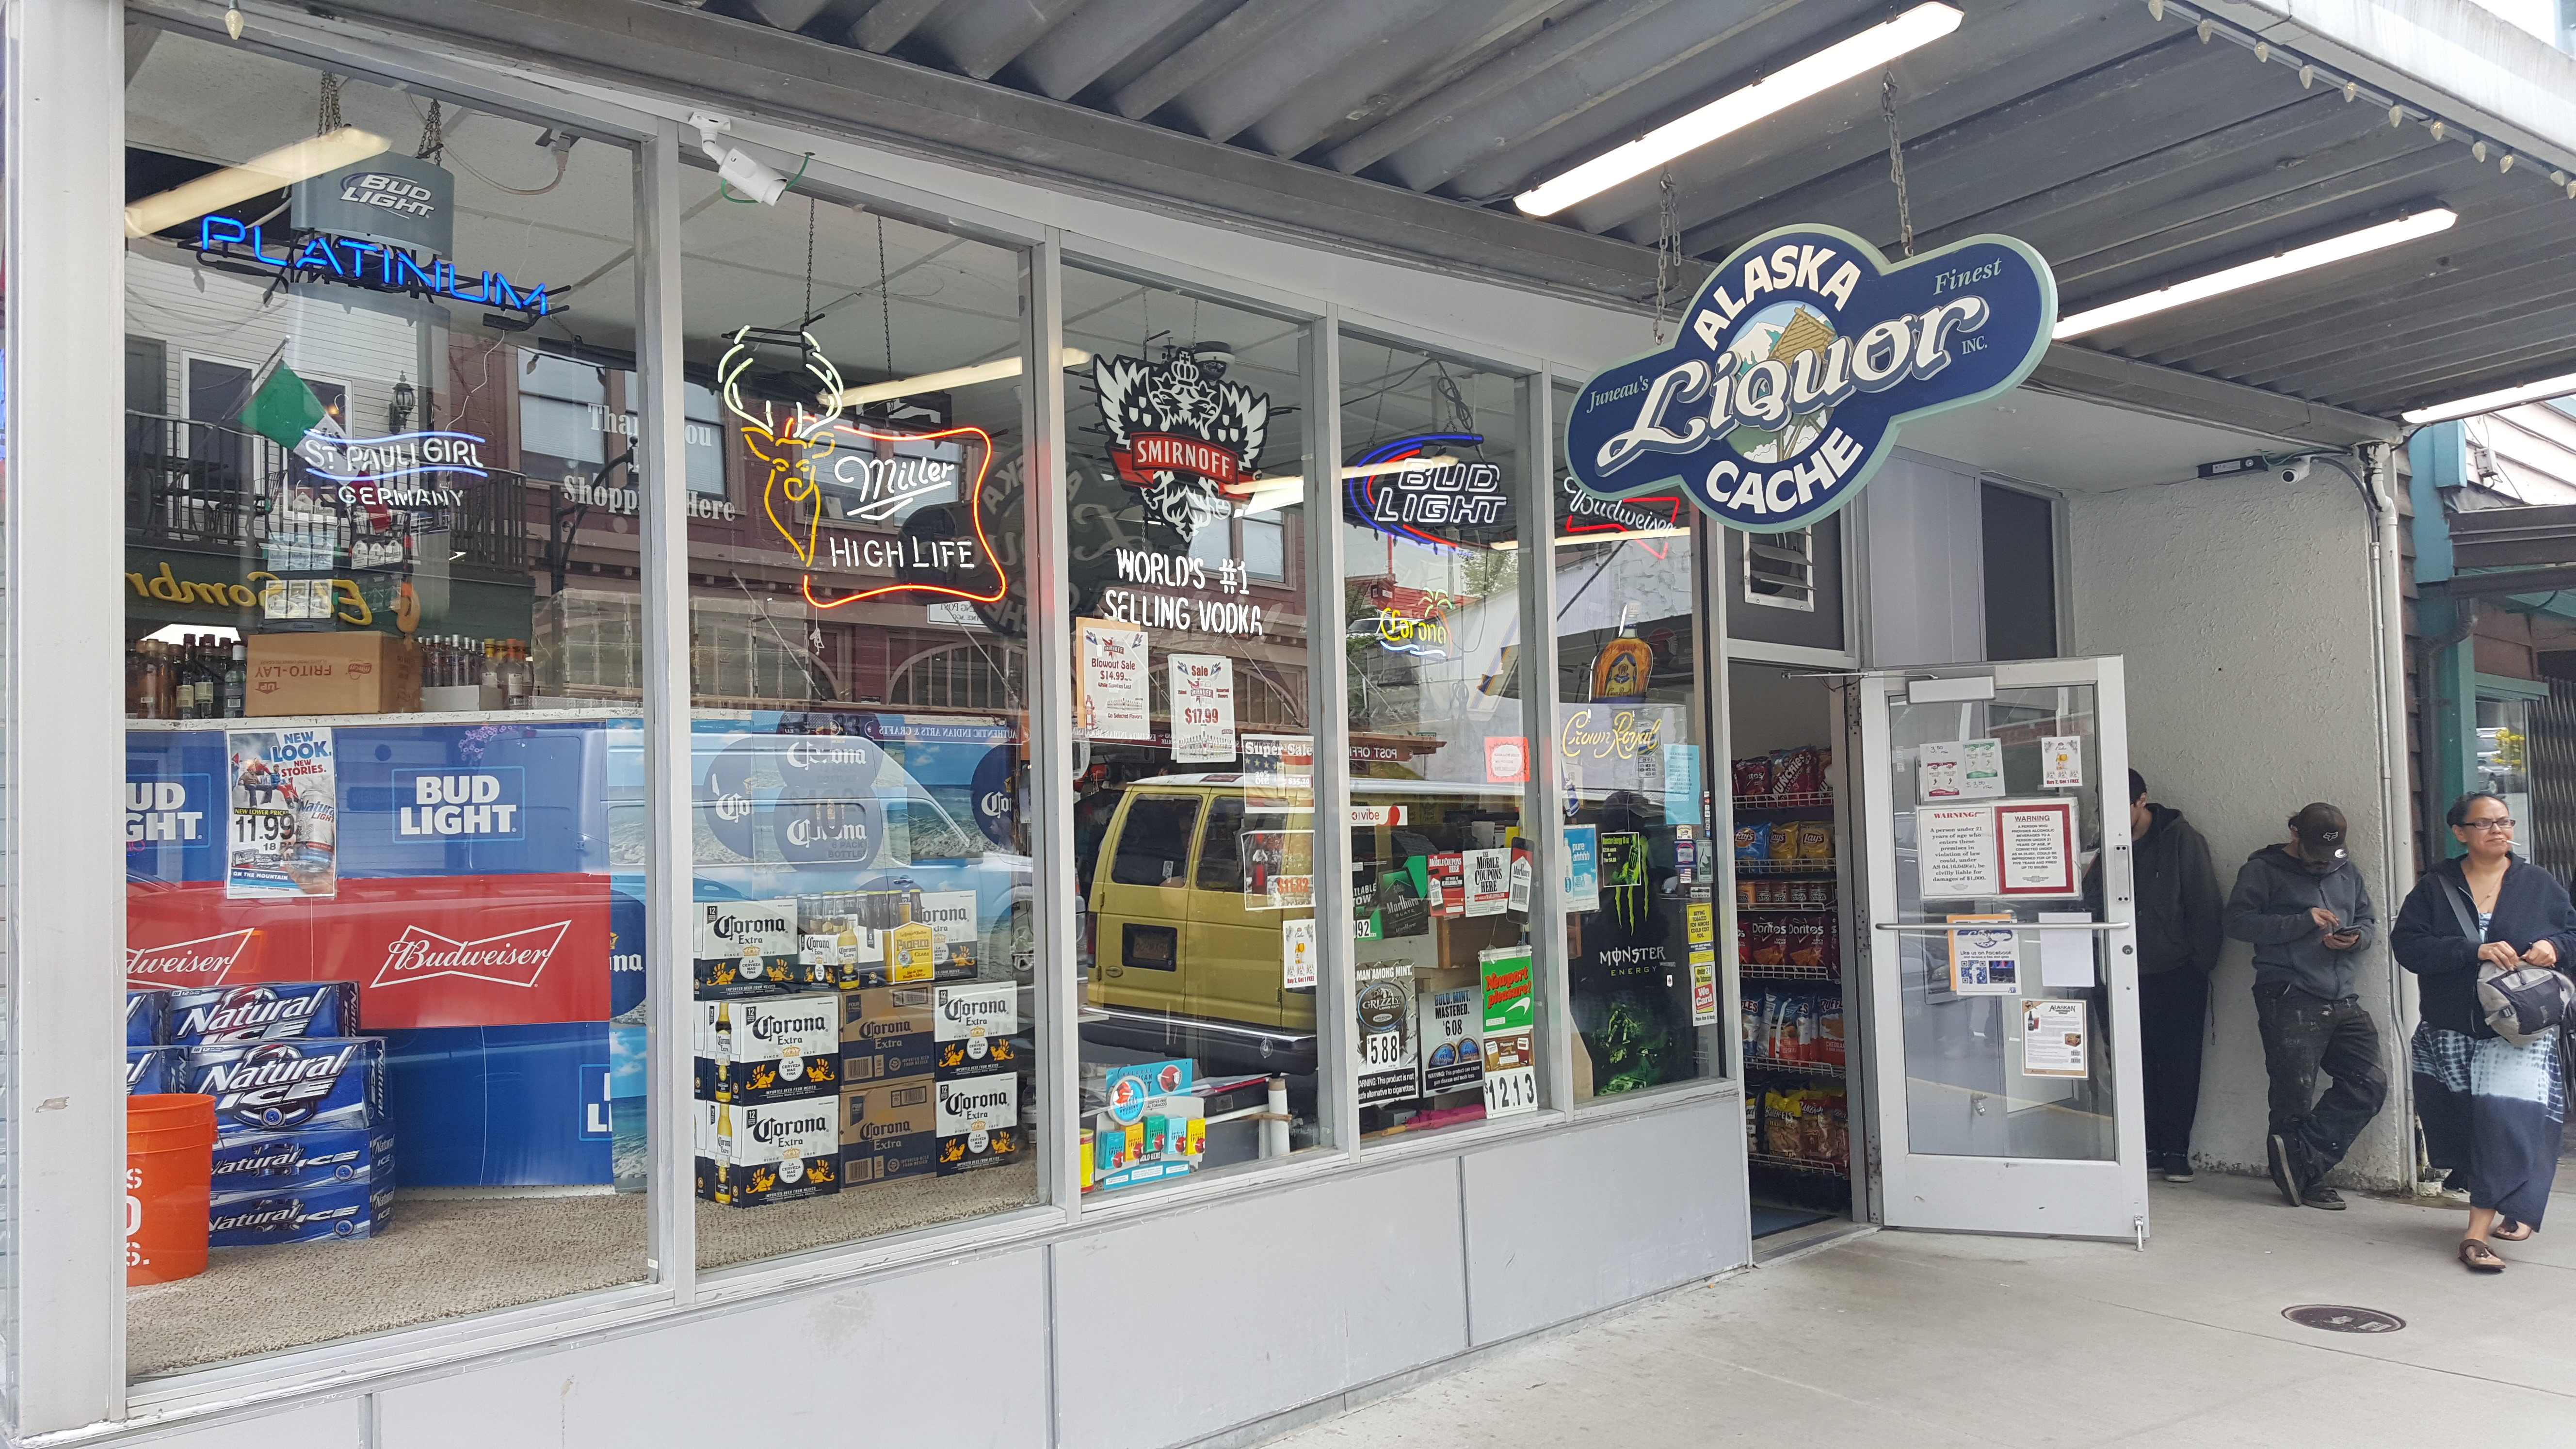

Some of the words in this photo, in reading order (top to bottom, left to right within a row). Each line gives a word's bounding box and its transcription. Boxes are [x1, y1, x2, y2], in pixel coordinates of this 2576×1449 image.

[361, 173, 433, 202] BUD
[340, 188, 435, 218] LIGHT
[201, 215, 550, 315] PLATINUM
[1933, 257, 2003, 295] Finest
[1692, 244, 1861, 351] ALASKA
[1962, 338, 1987, 356] INC.
[1586, 376, 1648, 414] Juneau's
[685, 424, 712, 447] ou
[347, 442, 416, 472] PAULI
[423, 438, 483, 467] GIRL
[1137, 440, 1230, 478] SMIRNOFF
[834, 456, 955, 502] Miller
[1398, 458, 1500, 492] BUD
[1705, 427, 1864, 514] CACHE
[339, 486, 463, 507] GERMANY
[564, 475, 639, 515] Shopp
[687, 491, 735, 521] Here
[1374, 487, 1507, 523] LIGHT
[1564, 477, 1676, 537] Budweiser
[830, 537, 903, 568] HIGH
[913, 536, 974, 568] LIFE
[1116, 548, 1204, 589] WORLD'S
[1219, 558, 1249, 595] #1
[1105, 589, 1190, 630] SELLING
[1198, 600, 1262, 635] VODKA
[255, 665, 331, 678] FRITO-LAY
[1092, 658, 1119, 669] Blowout
[1121, 660, 1135, 670] Sale
[1191, 665, 1208, 676] Sale
[1100, 671, 1124, 681] $14.99
[1185, 708, 1219, 724] $17.99
[284, 731, 313, 744] NEW
[1562, 711, 1611, 758] Crown
[1594, 712, 1661, 759] Royal
[271, 741, 331, 762] LOOK.
[1245, 742, 1282, 757] Super
[1288, 743, 1312, 756] Sale
[281, 764, 327, 777] STORIES.
[294, 759, 311, 767] NEW
[127, 782, 186, 811] UD
[416, 775, 500, 805] BUD
[400, 805, 516, 835] LIGHT
[1361, 811, 1379, 820] vibe
[127, 812, 203, 841] GHT
[236, 814, 294, 843] 11.99
[1572, 843, 1584, 853] pure
[1573, 852, 1590, 861] ahhhh
[1477, 857, 1499, 869] MOBILE
[1475, 869, 1502, 885] COUPONS
[1481, 881, 1497, 893] HERE
[1387, 895, 1418, 914] Marlboro
[713, 915, 786, 940] Corona
[1753, 923, 1787, 934] Doritos
[1789, 923, 1823, 935] Doritos
[739, 935, 763, 945] Extra
[897, 939, 930, 951] PACIFICO
[127, 949, 232, 974] dweiser
[388, 939, 550, 970] Budweiser
[1599, 946, 1665, 966] MONSTER
[1357, 969, 1370, 981] MAN
[1372, 967, 1394, 979] AMONG
[1396, 966, 1412, 977] MINT.
[1485, 966, 1529, 990] Newport
[1610, 966, 1657, 976] ENERGY
[1434, 993, 1451, 1006] BOLD.
[1453, 990, 1470, 1003] MINT.
[1487, 981, 1531, 1009] pleasure!
[1696, 995, 1712, 1006] Card
[1698, 987, 1709, 997] We
[175, 986, 331, 1039] Natural
[944, 998, 1007, 1022] Corona
[1362, 997, 1401, 1009] GRIZZLY
[1435, 1003, 1470, 1019] MASTERED.
[199, 1019, 309, 1044] ICE
[753, 1014, 825, 1042] Corona
[859, 1021, 911, 1040] Corona
[966, 1017, 987, 1026] Extra
[777, 1035, 803, 1045] Extra
[875, 1038, 902, 1049] Extra
[196, 1045, 358, 1094] Natural
[215, 1078, 337, 1111] ICE
[946, 1092, 1007, 1117] Corona
[966, 1111, 988, 1120] Extra
[753, 1117, 826, 1144] Corona
[860, 1121, 911, 1142] Corona
[778, 1138, 803, 1147] Extra
[874, 1140, 901, 1151] Extra
[296, 1150, 360, 1167] ICE
[295, 1206, 360, 1222] ICE
